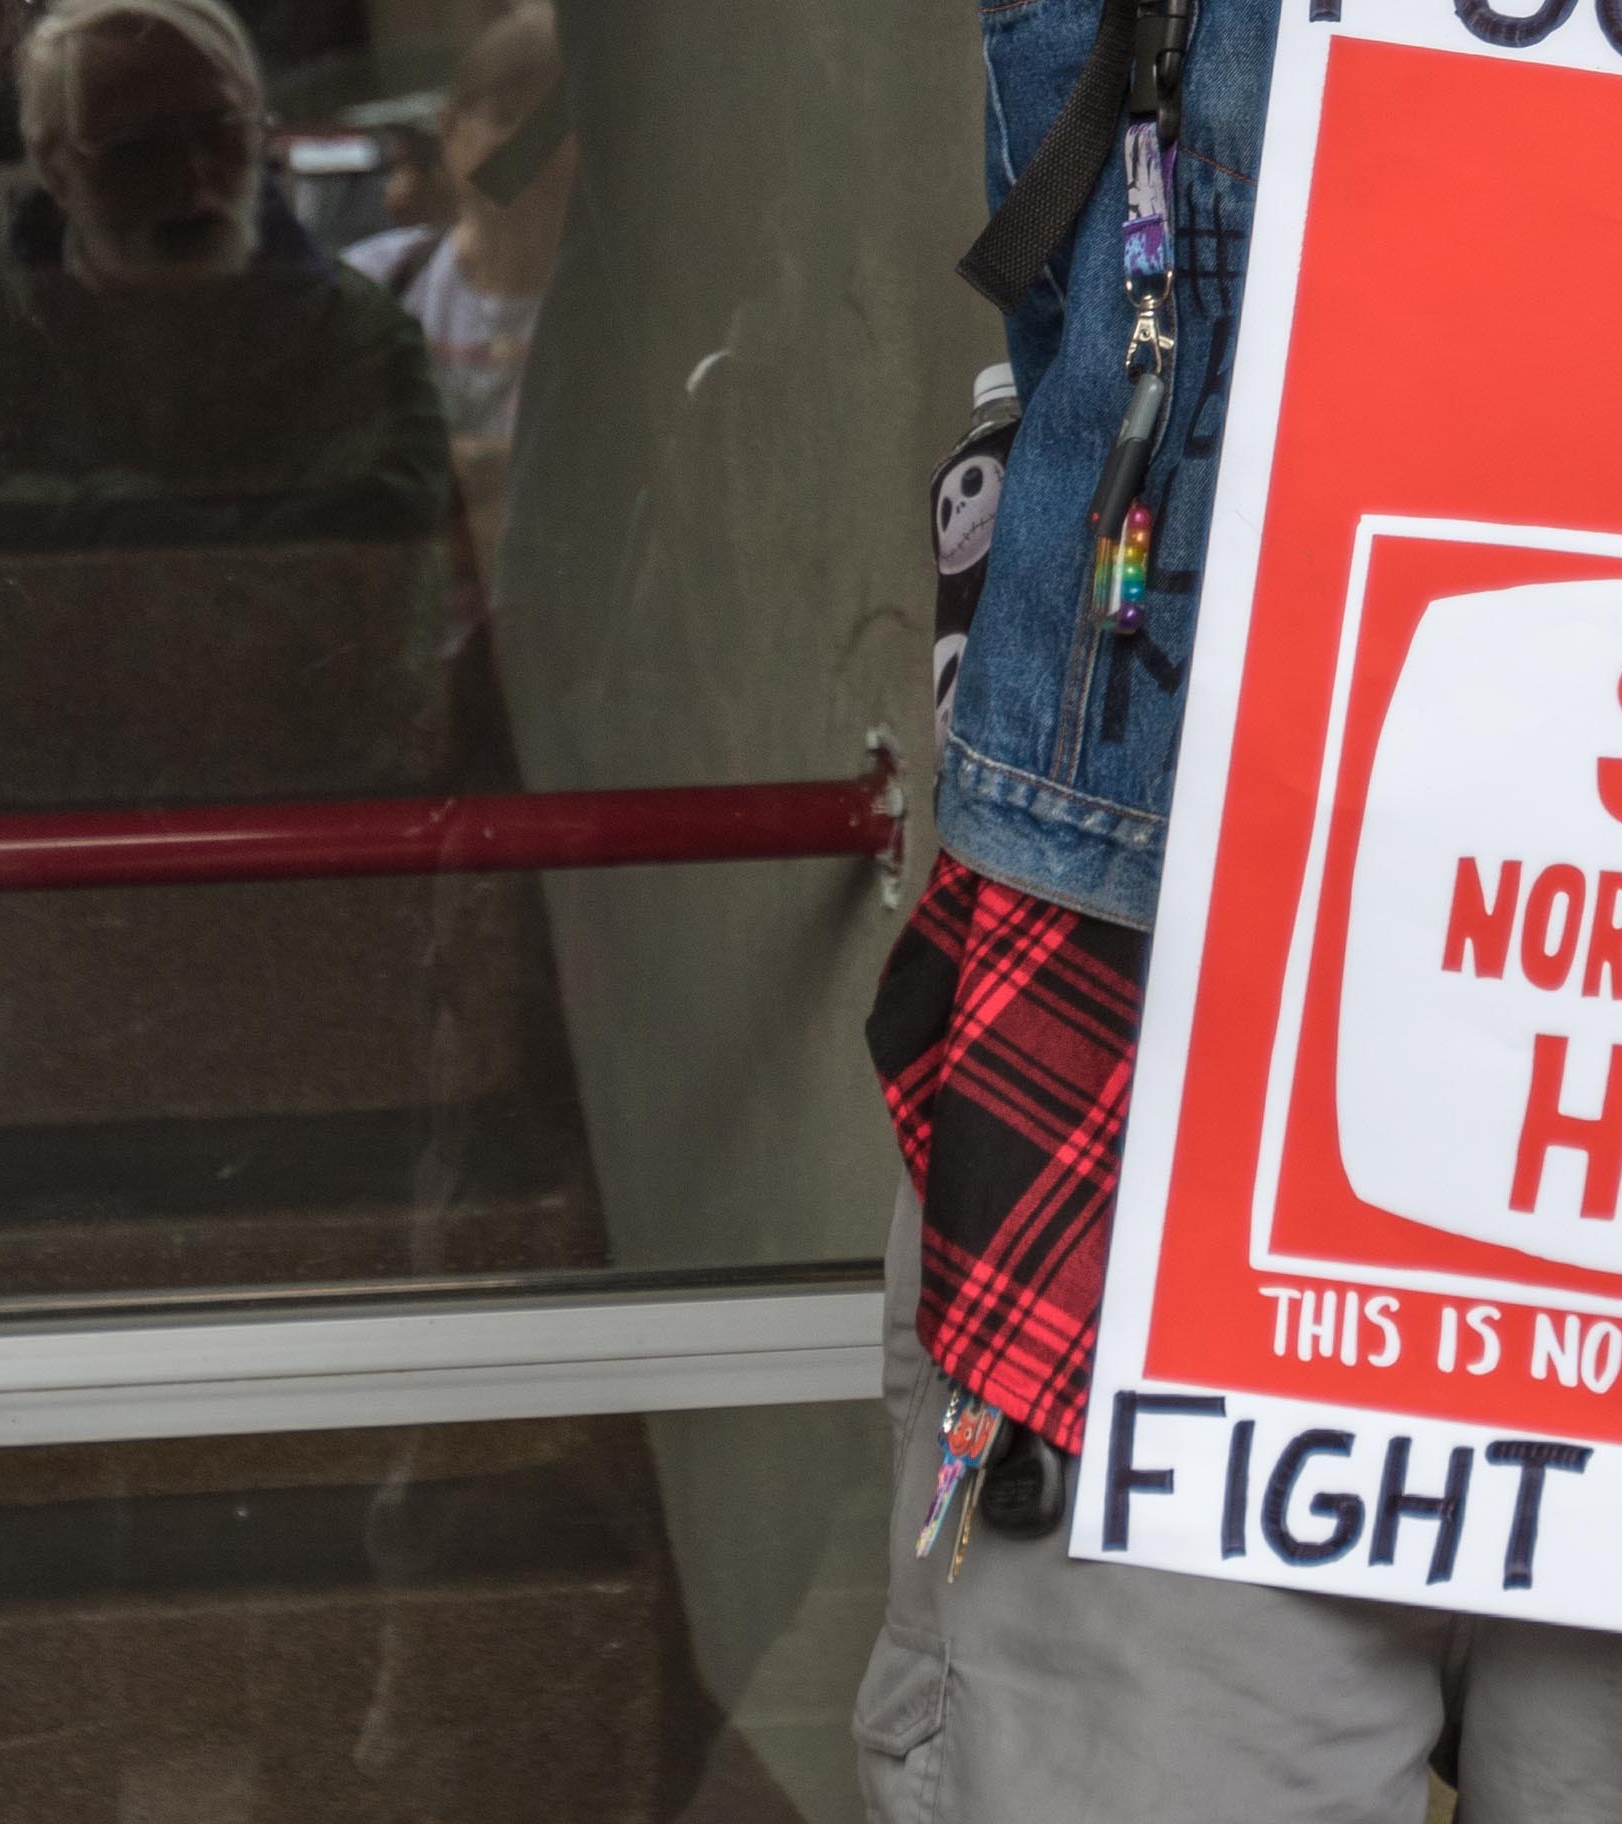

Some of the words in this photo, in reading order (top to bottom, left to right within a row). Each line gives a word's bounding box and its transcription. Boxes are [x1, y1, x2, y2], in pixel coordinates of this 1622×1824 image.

[1259, 1286, 1402, 1368] THIS
[1437, 1305, 1502, 1376] IS
[1101, 1389, 1595, 1591] FIGHT
